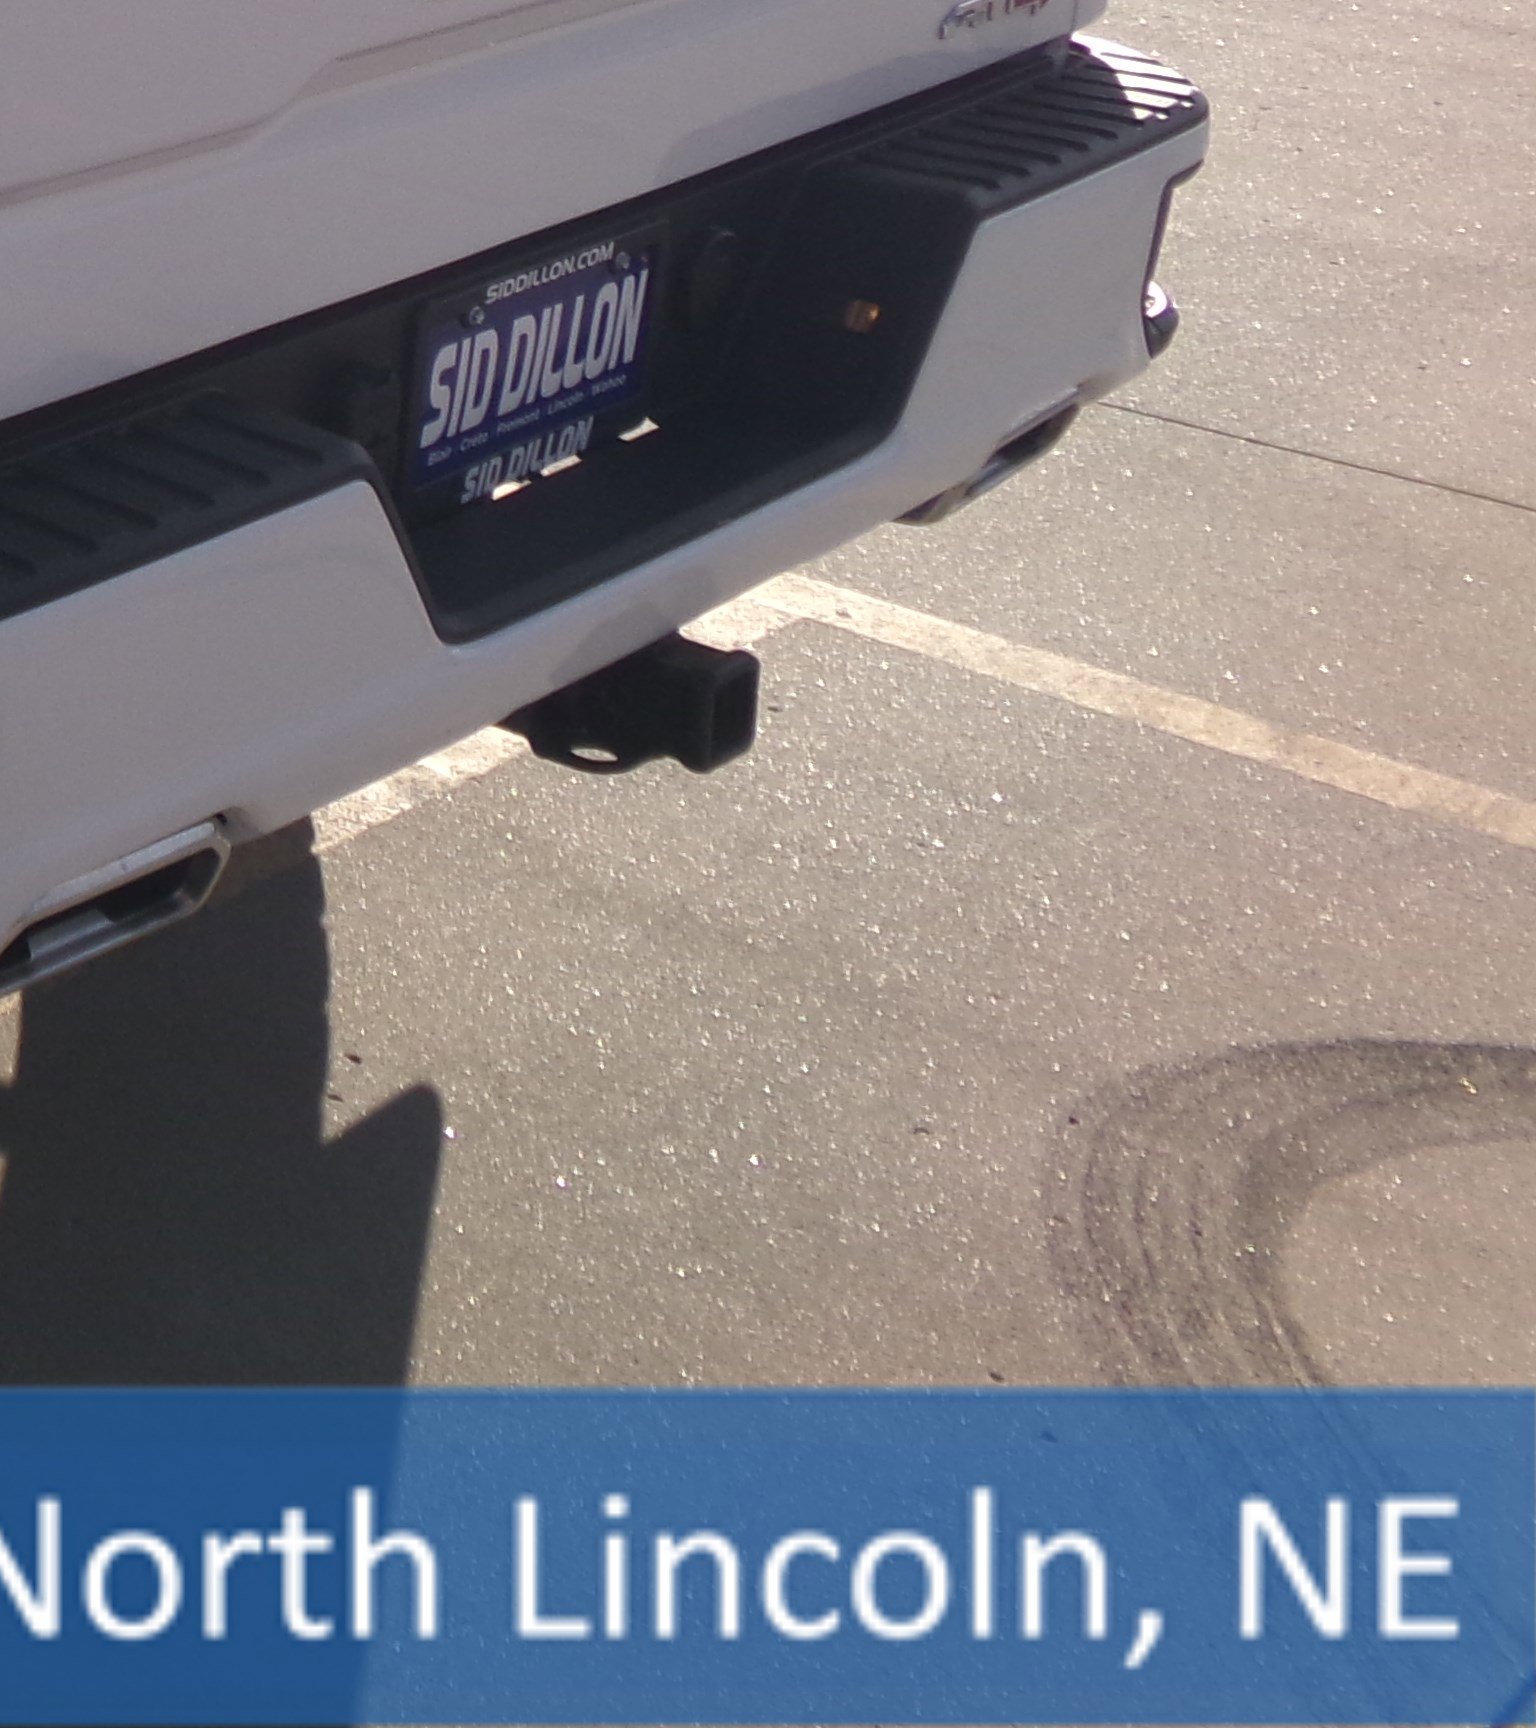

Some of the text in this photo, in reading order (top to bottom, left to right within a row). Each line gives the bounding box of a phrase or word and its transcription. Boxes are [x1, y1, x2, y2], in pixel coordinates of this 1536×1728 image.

[484, 241, 615, 304] SIDDILLON.COM
[420, 268, 649, 449] SID DILLON
[460, 456, 503, 504] SID
[505, 415, 594, 483] DILLON
